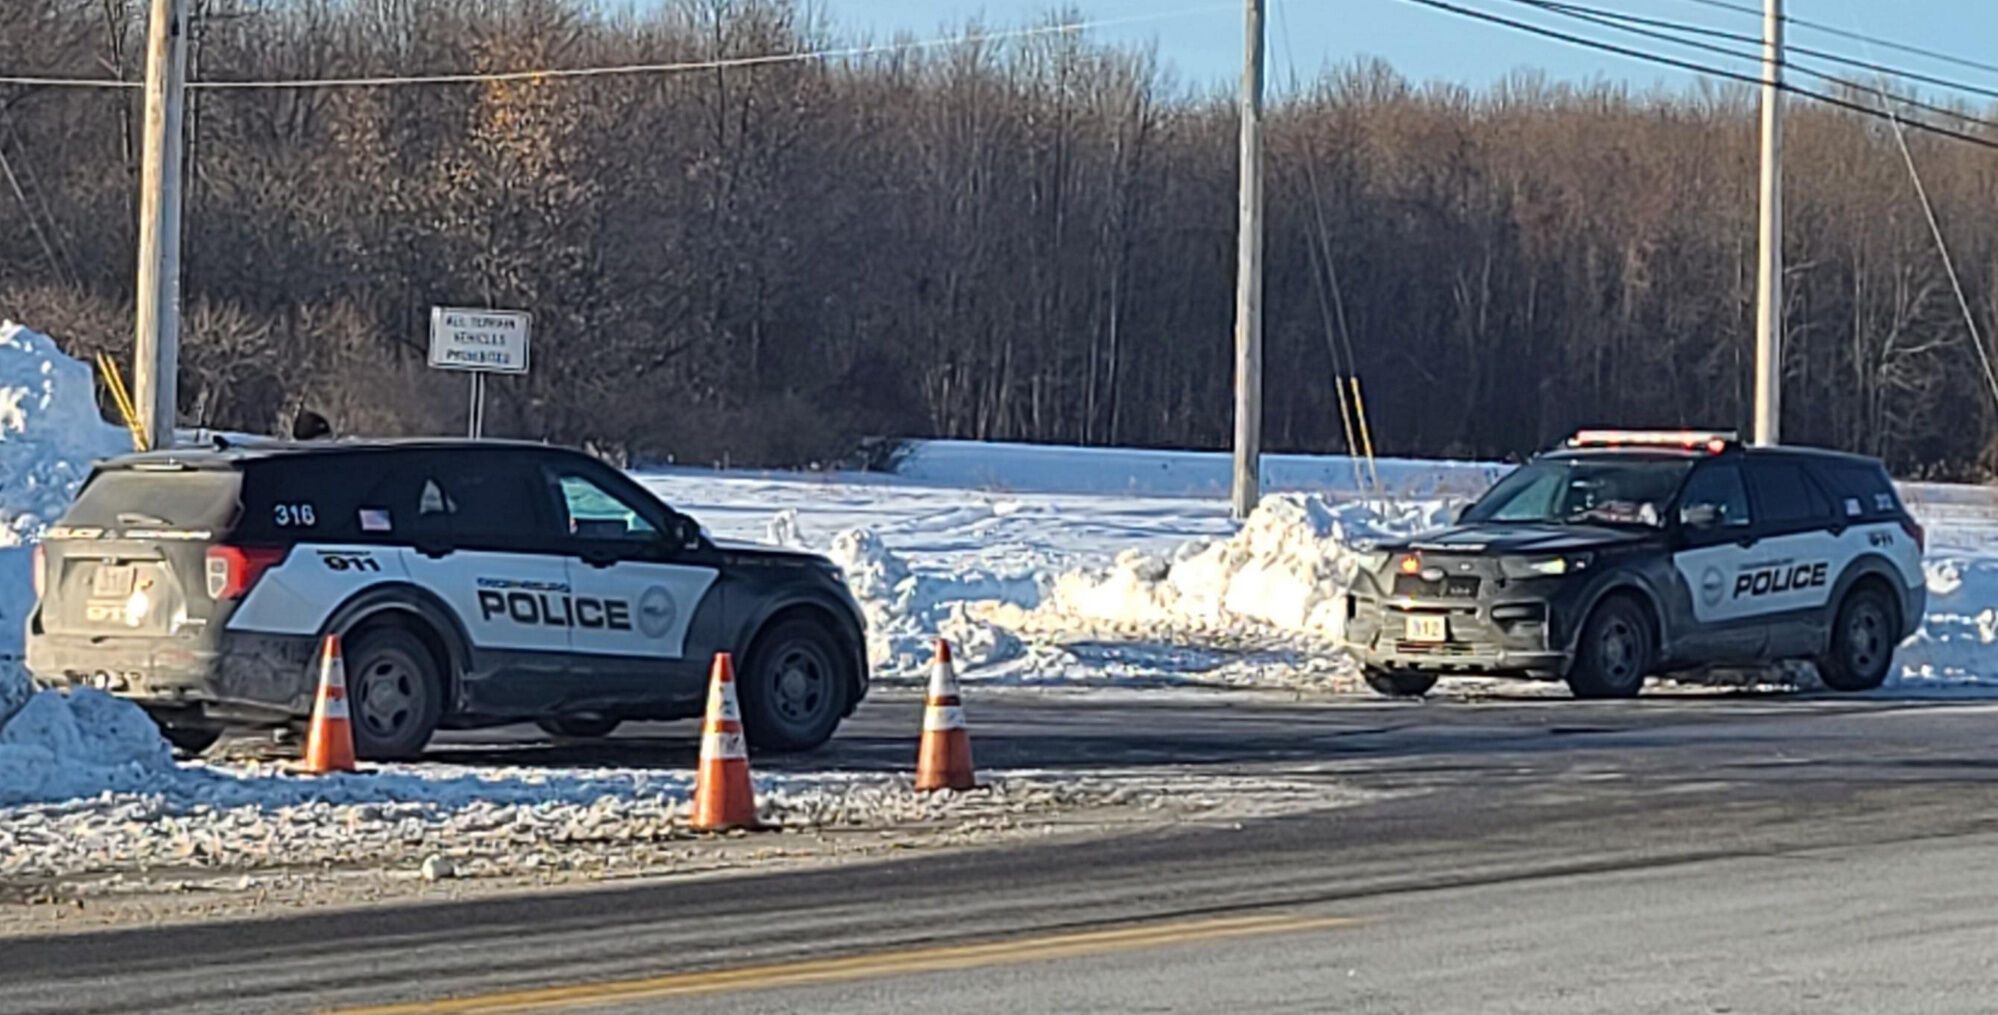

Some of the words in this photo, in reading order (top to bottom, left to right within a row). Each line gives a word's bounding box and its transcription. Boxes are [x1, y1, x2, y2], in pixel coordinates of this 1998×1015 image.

[322, 555, 381, 572] 911
[1733, 562, 1828, 599] POLICE
[477, 590, 632, 630] POLICE
